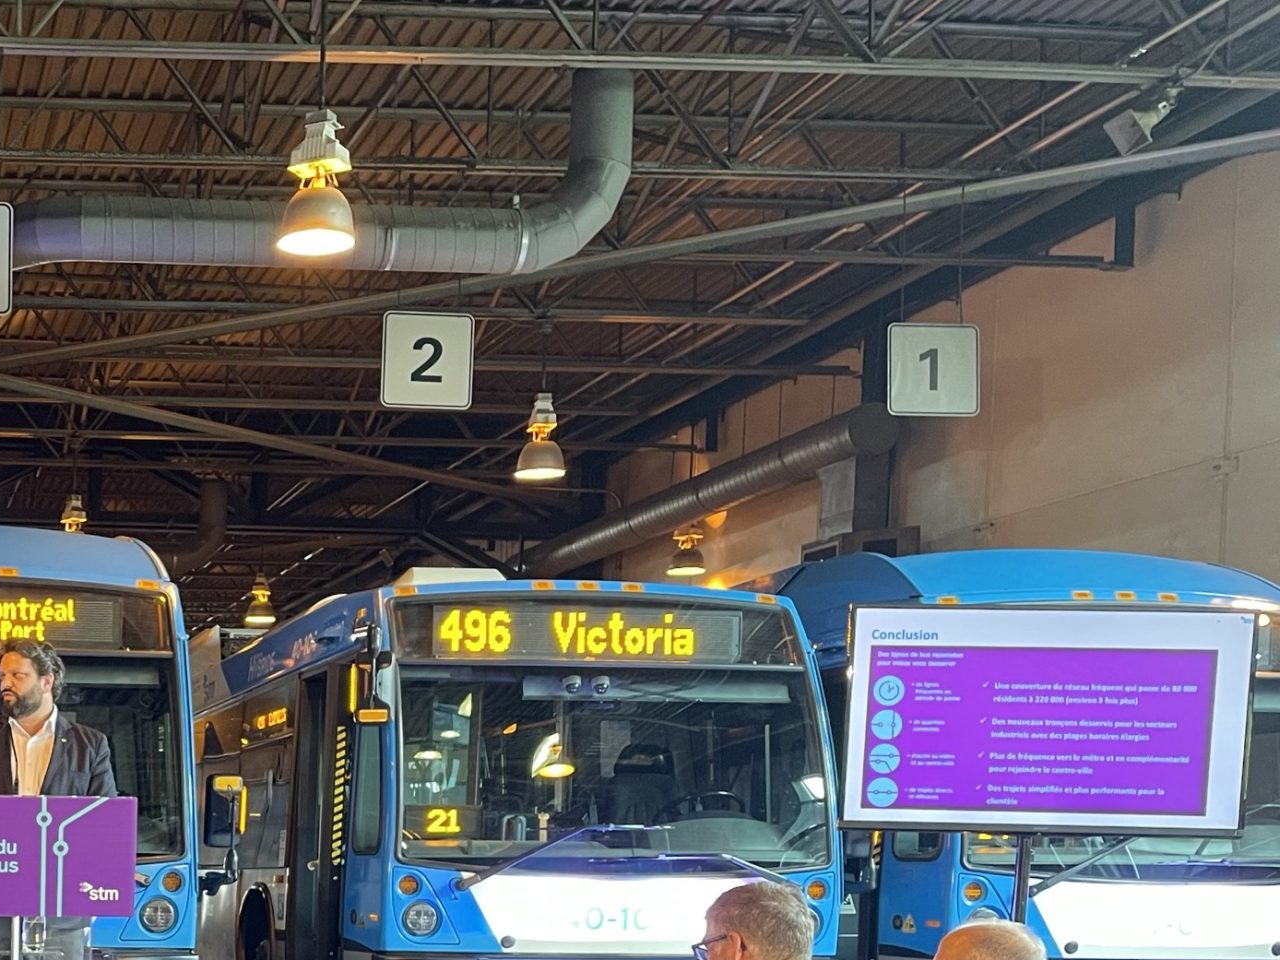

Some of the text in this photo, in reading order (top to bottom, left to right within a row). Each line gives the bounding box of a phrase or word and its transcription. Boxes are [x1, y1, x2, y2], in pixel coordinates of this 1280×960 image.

[410, 337, 443, 383] 2
[919, 348, 938, 391] 1
[440, 609, 694, 656] 496 Victoria
[871, 629, 939, 641] Conclusion
[427, 808, 461, 832] 21
[89, 886, 119, 901] stm
